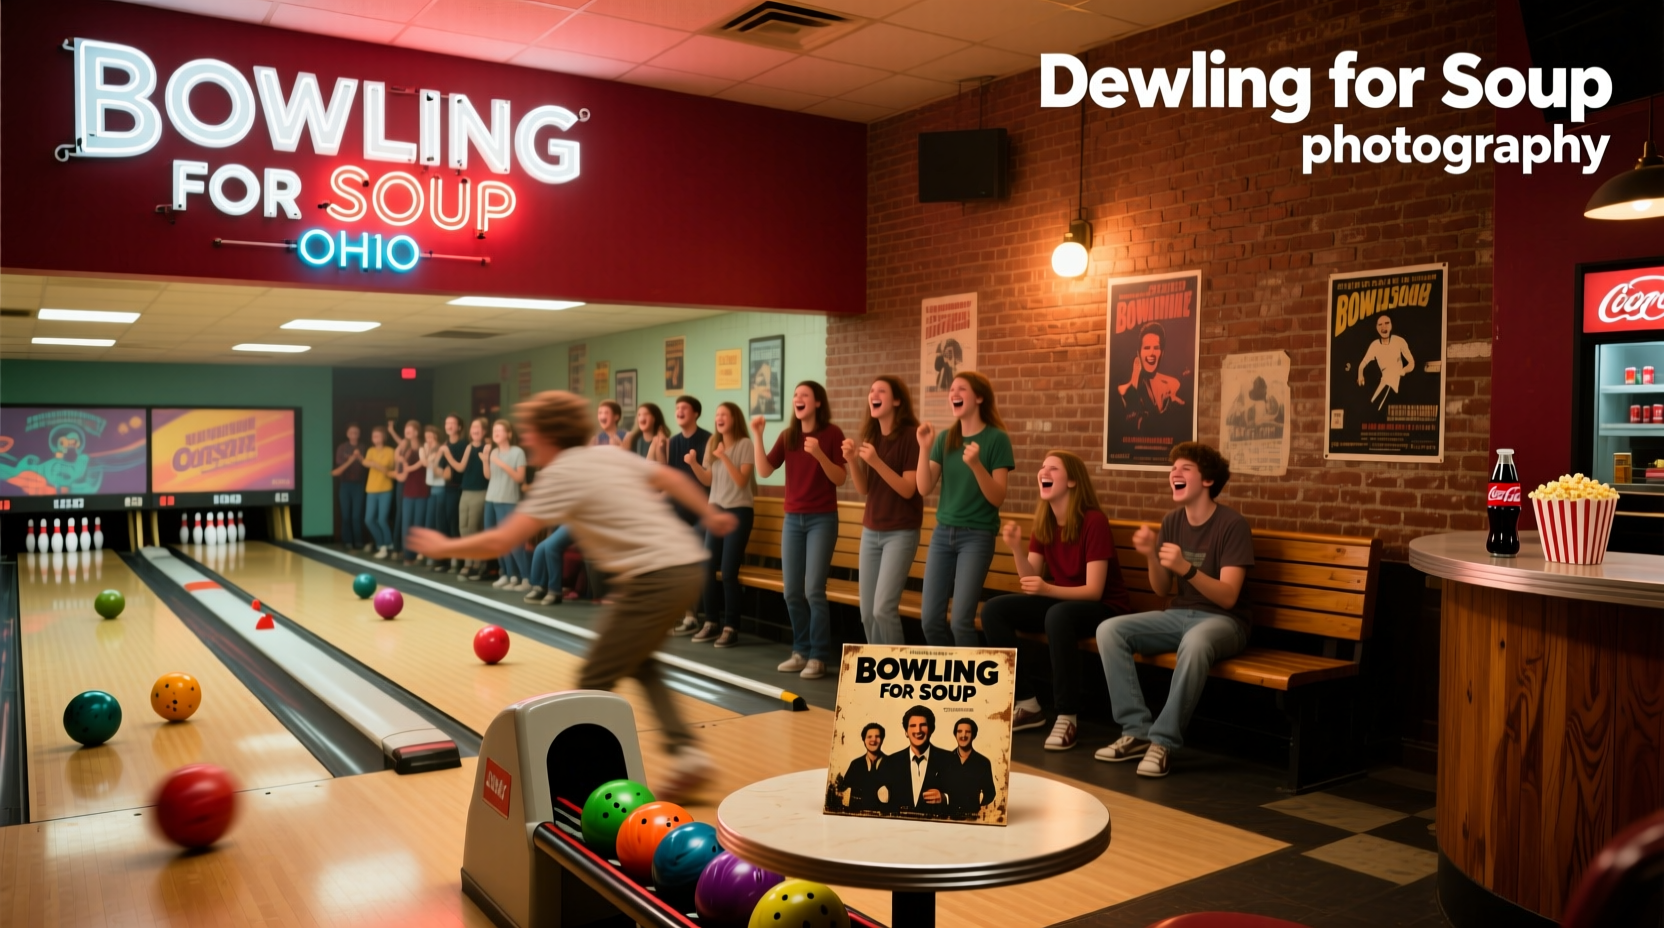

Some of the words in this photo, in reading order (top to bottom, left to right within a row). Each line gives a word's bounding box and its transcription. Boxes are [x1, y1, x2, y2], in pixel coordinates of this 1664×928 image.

[74, 38, 581, 185] BOWLING
[172, 160, 302, 219] FOR
[326, 165, 517, 232] SOUP
[299, 229, 421, 272] OHIO
[856, 657, 999, 686] BOWLING
[880, 683, 914, 699] FOR
[919, 684, 977, 702] SOUP
